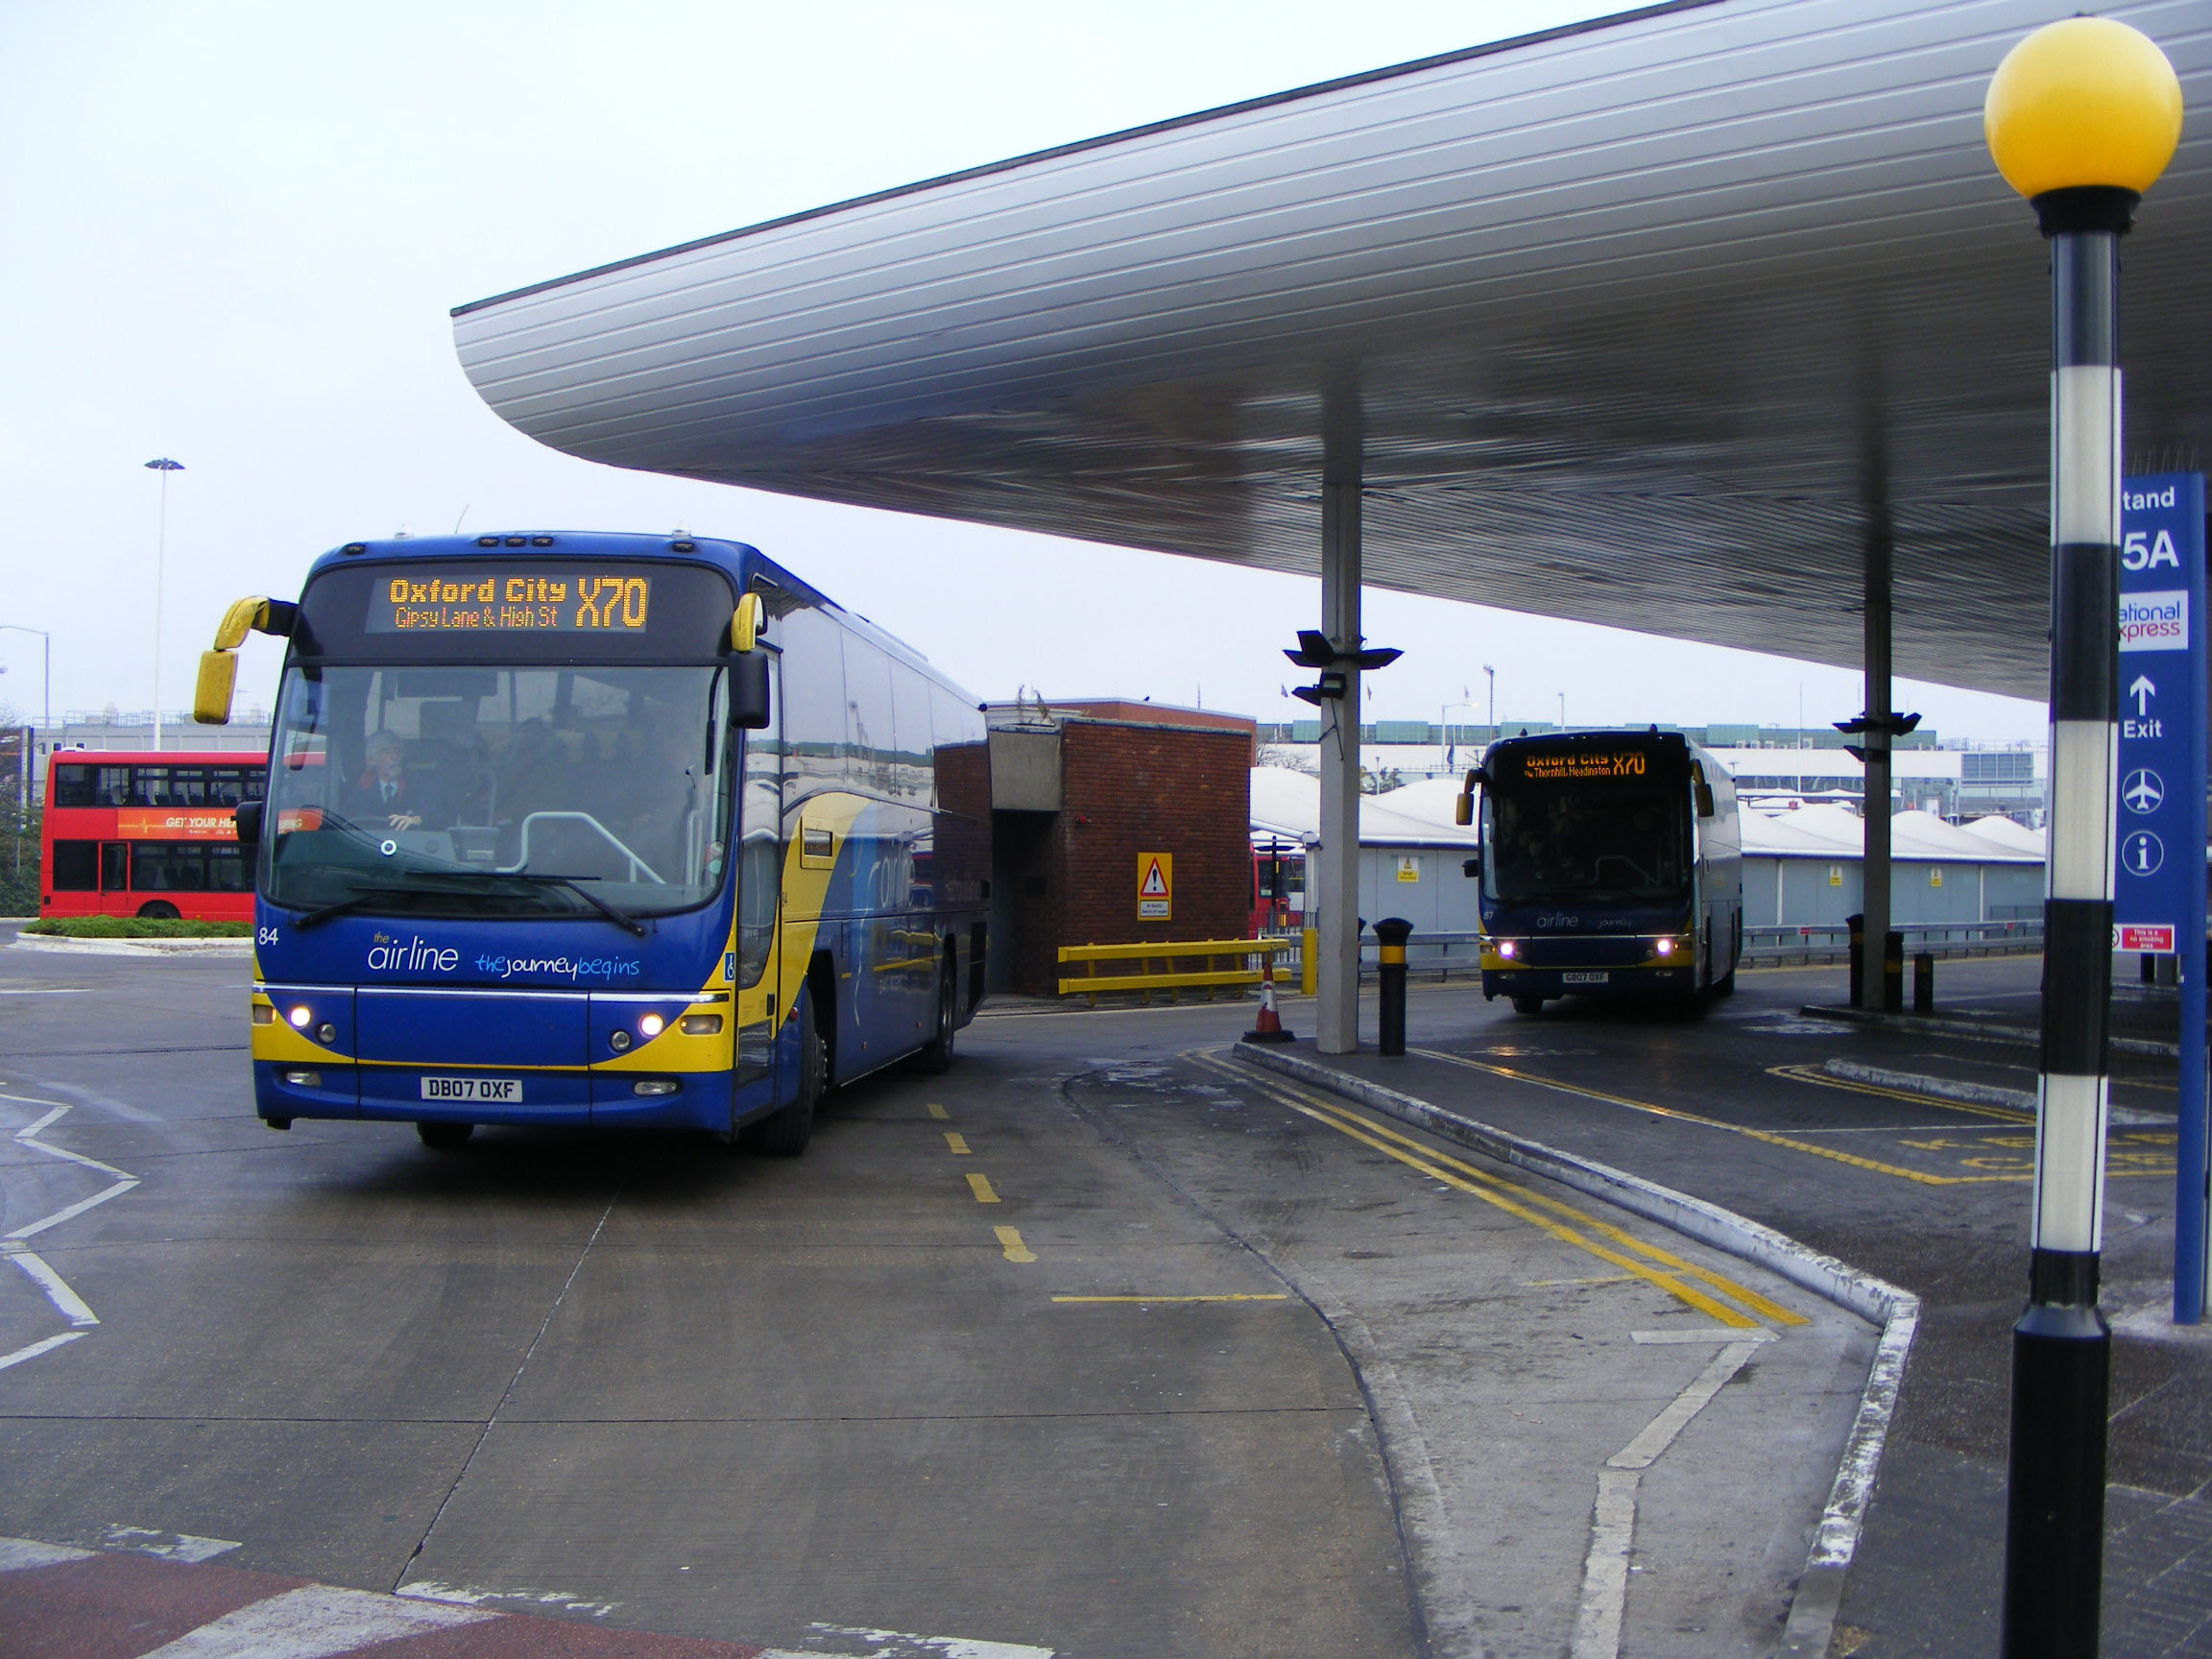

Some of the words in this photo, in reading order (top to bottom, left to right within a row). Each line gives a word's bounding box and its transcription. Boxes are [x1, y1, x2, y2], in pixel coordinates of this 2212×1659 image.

[2123, 486, 2176, 511] tand
[390, 579, 494, 603] Oxford
[505, 578, 566, 603] City
[576, 578, 647, 627] X70
[2119, 600, 2180, 622] ational
[395, 607, 439, 628] Gipsy
[442, 607, 480, 627] Lane
[483, 607, 495, 627] &
[500, 606, 534, 627] High
[538, 606, 558, 627] St
[2119, 622, 2180, 643] xpress
[2124, 719, 2162, 738] Exit
[1527, 755, 1575, 767] Oxford
[1580, 753, 1609, 765] City
[1613, 752, 1646, 775] X70
[1569, 766, 1611, 777] Headington
[166, 817, 186, 828] GET
[189, 817, 216, 828] YOUR
[1537, 912, 1578, 928] airline
[258, 926, 278, 946] 84
[373, 931, 390, 944] the
[368, 935, 459, 972] airline
[1588, 973, 1606, 982] OXF
[428, 1079, 475, 1097] DB07
[480, 1081, 515, 1098] OXF
